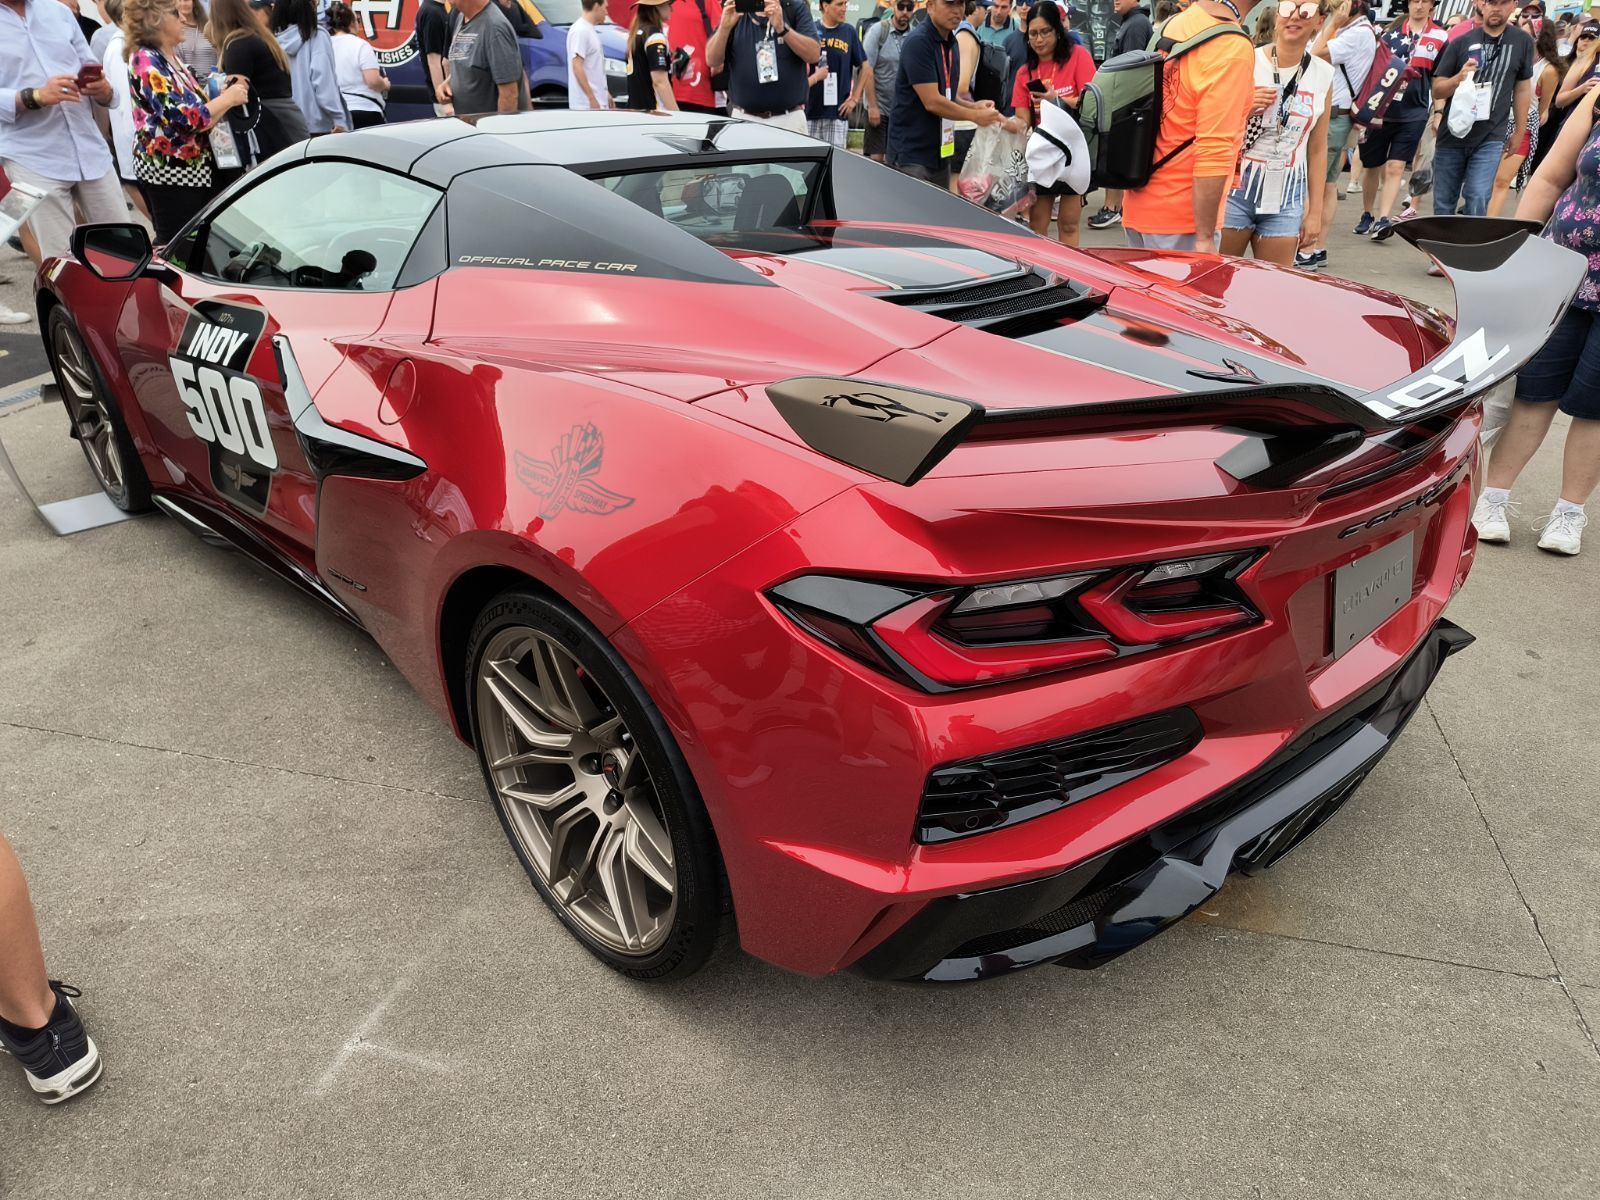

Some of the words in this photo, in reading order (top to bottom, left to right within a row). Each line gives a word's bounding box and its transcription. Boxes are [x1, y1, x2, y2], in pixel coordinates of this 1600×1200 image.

[458, 255, 535, 266] OFFICIAL
[539, 258, 592, 269] PACE
[594, 261, 638, 272] CAR
[186, 321, 250, 367] INDY
[1363, 327, 1511, 420] 107
[169, 356, 279, 470] 500
